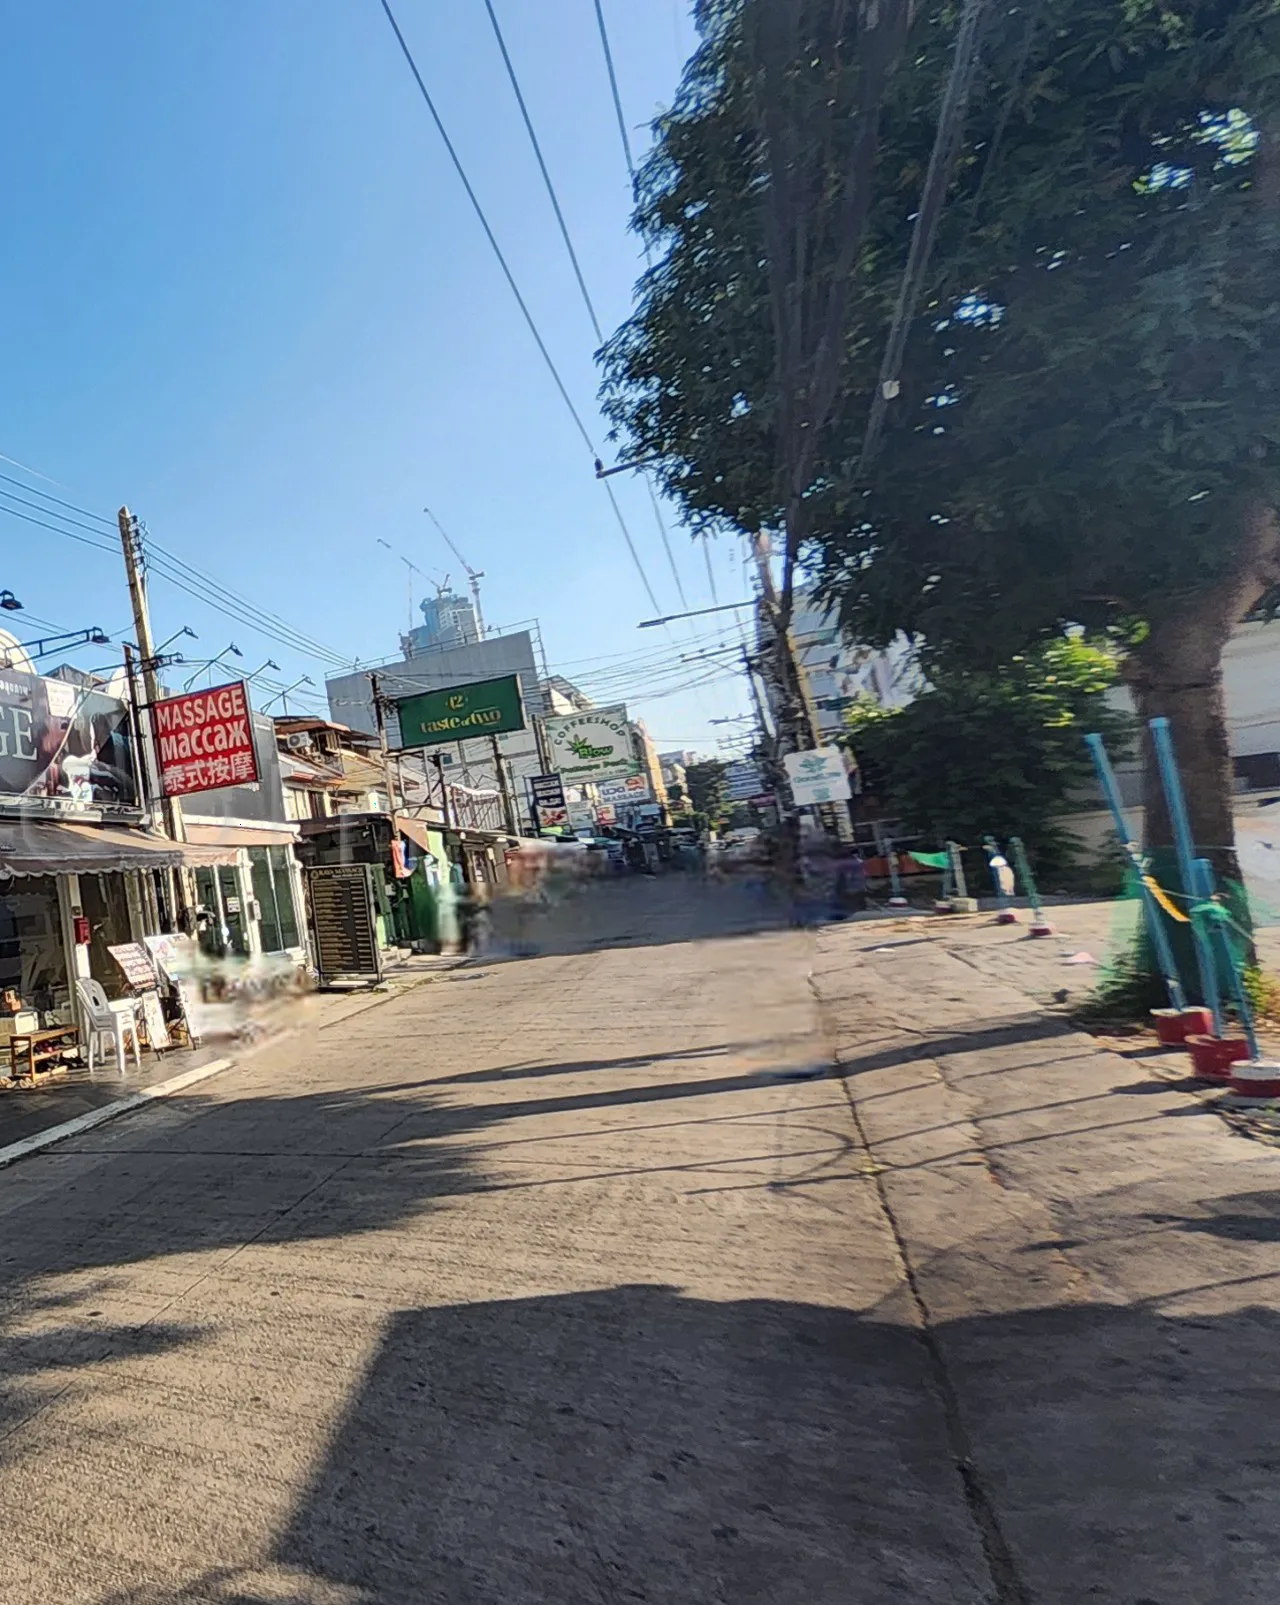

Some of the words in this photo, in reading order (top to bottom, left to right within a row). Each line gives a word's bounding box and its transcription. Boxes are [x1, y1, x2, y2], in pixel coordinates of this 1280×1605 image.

[157, 689, 246, 733] MASSAGE
[553, 716, 626, 746] COFFEESHOP
[163, 750, 254, 792] 泰式按摩
